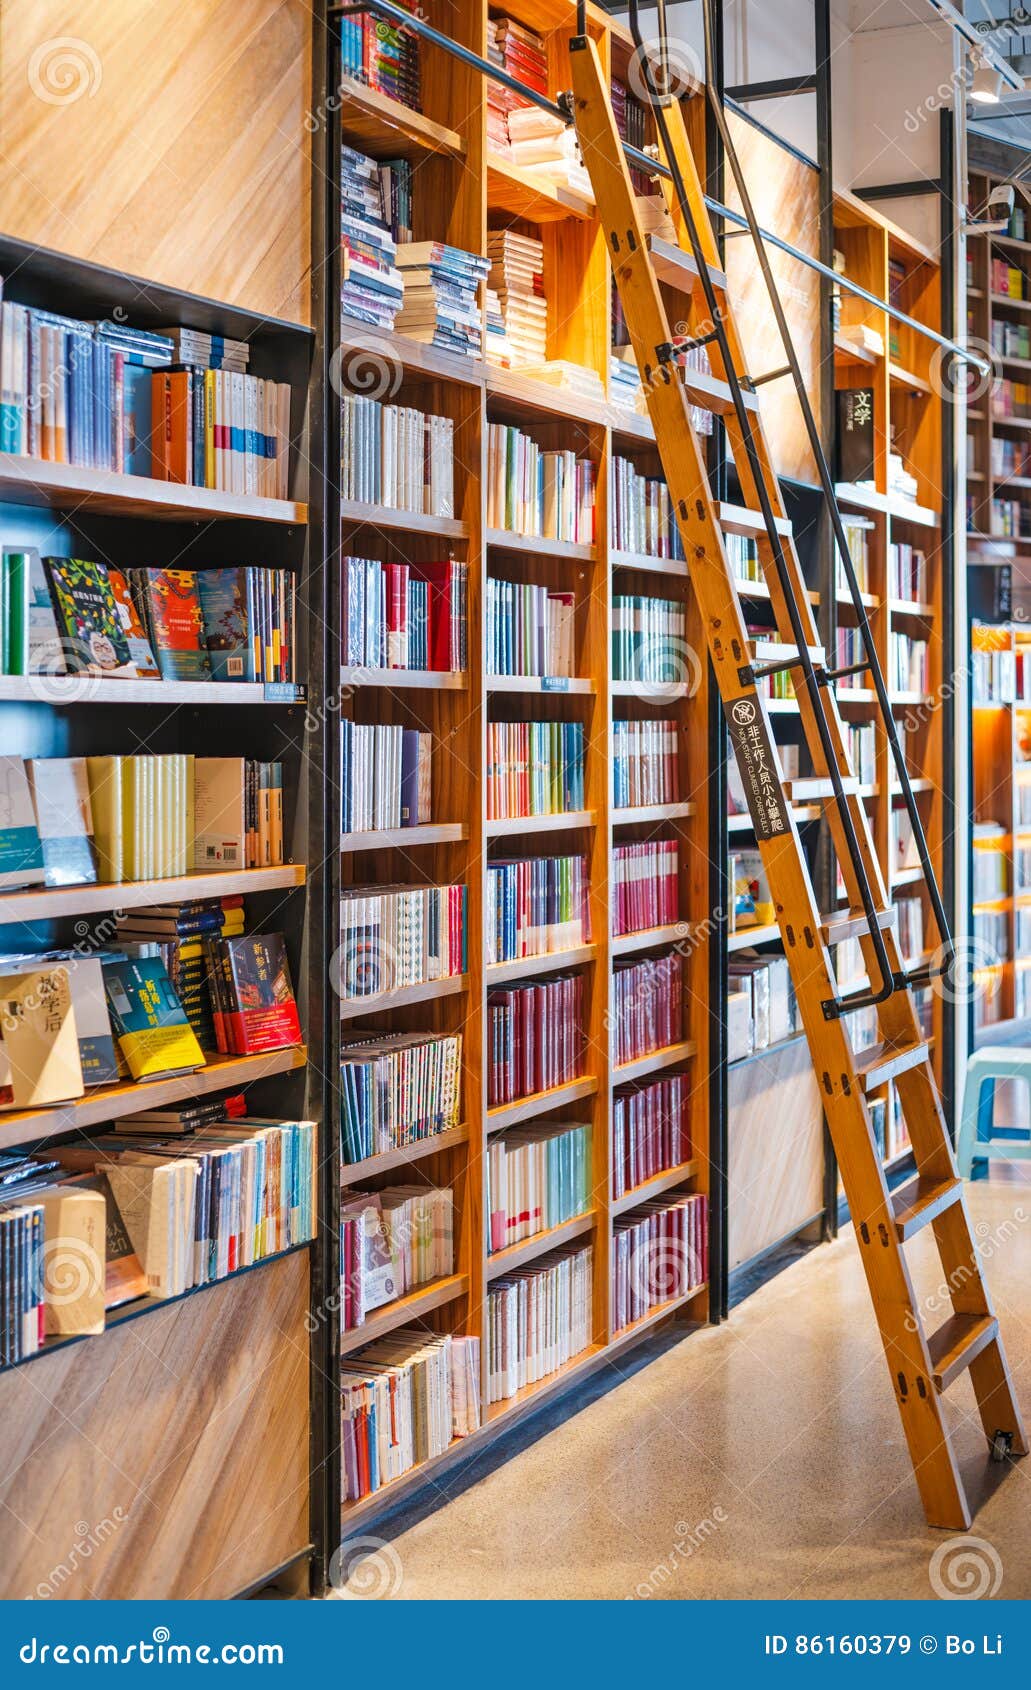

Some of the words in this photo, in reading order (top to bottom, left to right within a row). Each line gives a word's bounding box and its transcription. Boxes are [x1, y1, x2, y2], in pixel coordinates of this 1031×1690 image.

[854, 391, 871, 426] 文学
[748, 725, 785, 832] 非工作人员小心攀爬
[755, 795, 770, 834] CAREFULLY
